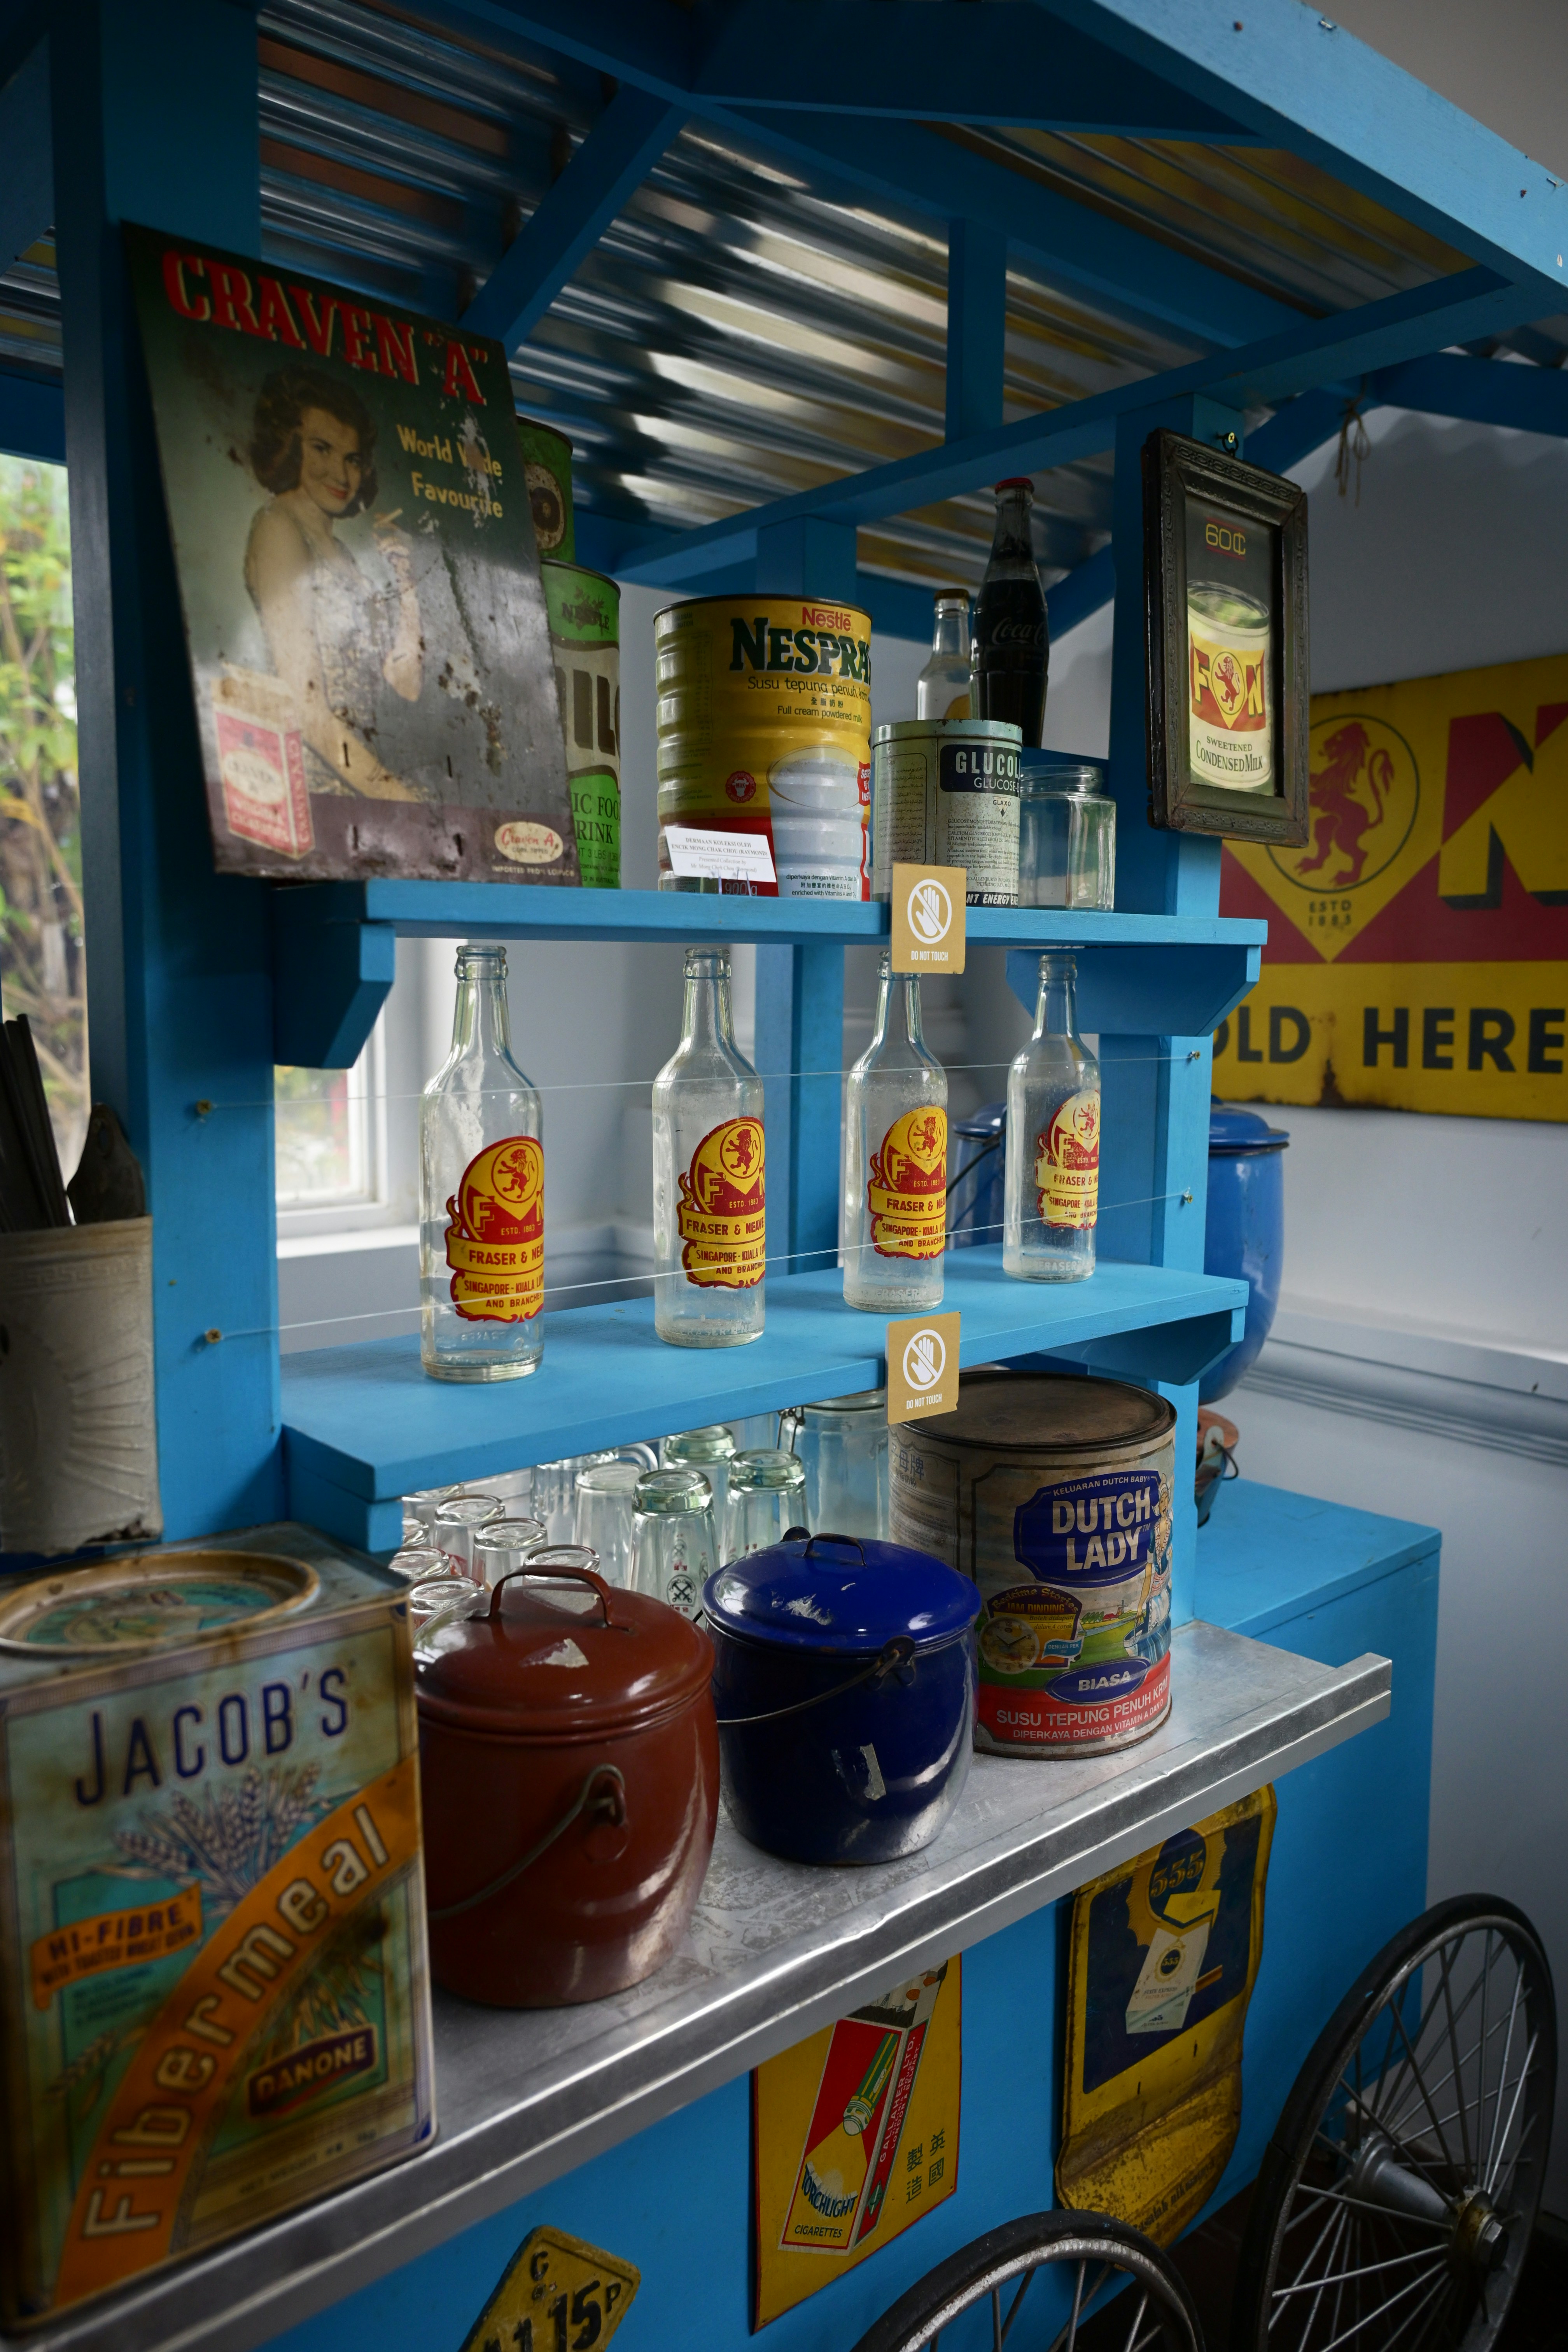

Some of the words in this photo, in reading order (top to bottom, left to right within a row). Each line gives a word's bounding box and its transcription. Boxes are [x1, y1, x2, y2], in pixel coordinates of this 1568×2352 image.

[162, 251, 419, 385] CRAVEN
[396, 424, 453, 464] World
[729, 617, 871, 687] NESPRA
[748, 677, 779, 689] Susu
[784, 677, 828, 694] tepung
[831, 684, 858, 698] penuh
[778, 705, 792, 714] Full
[794, 708, 819, 716] cream
[822, 710, 852, 720] powdered
[854, 714, 862, 723] milk
[1206, 735, 1252, 752] SWEETENED
[1196, 739, 1244, 772] CONDENSED
[1244, 751, 1263, 772] MILK
[597, 796, 621, 821] FOO
[576, 820, 613, 845] RINK
[725, 882, 747, 895] 900
[983, 894, 1010, 905] ENERGY
[1309, 900, 1352, 913] ESTD
[1309, 913, 1352, 927] 1883
[911, 951, 919, 961] DO
[920, 951, 930, 961] NOT
[931, 951, 948, 961] TOUCH
[1363, 1006, 1565, 1075] HERE
[1054, 1173, 1086, 1186] FRASER
[748, 1198, 758, 1206] 1883
[887, 1198, 924, 1213] FRASER
[928, 1201, 933, 1211] &
[1049, 1196, 1081, 1208] SINGAPORE
[523, 1225, 535, 1233] 1883
[686, 1219, 728, 1236] FRASER
[734, 1223, 741, 1235] &
[746, 1216, 764, 1234] NEAVE
[923, 1225, 938, 1236] KUALA
[899, 1238, 914, 1247] AND
[918, 1234, 944, 1247] BRANCHES
[469, 1250, 516, 1266] FRASER
[520, 1251, 528, 1264] &
[742, 1249, 758, 1261] KUALA
[716, 1265, 732, 1274] AND
[737, 1259, 764, 1274] BRANCHES
[516, 1279, 535, 1293] KUALA
[486, 1298, 504, 1308] AND
[510, 1292, 542, 1307] BRANCHES
[906, 1399, 913, 1410] DO
[914, 1397, 924, 1408] NOT
[926, 1393, 942, 1405] TOUCH
[1053, 1480, 1100, 1496] KELUARAN
[1102, 1477, 1128, 1486] DUTCH
[1052, 1486, 1150, 1534] DUTCH
[1066, 1526, 1143, 1570] LADY
[992, 1588, 1037, 1609] Bedtime
[1041, 1587, 1078, 1613] Stories
[1007, 1603, 1024, 1612] JAM
[1028, 1603, 1064, 1613] DINDING
[1078, 1671, 1132, 1691] BIASA
[996, 1710, 1041, 1726] SUSU
[1046, 1708, 1110, 1726] TEPUNG
[1113, 1691, 1151, 1718] PENUH
[1013, 1729, 1070, 1739] DIPERKAYA
[1073, 1727, 1113, 1738] DENGAN
[1114, 1714, 1143, 1730] VITAMIN
[1150, 1704, 1160, 1716] DAN
[75, 1668, 348, 1807] JACOB'S
[1150, 1848, 1204, 1898] 555
[256, 2035, 367, 2100] DANONE
[880, 2077, 905, 2163] GALLAHER
[891, 2103, 906, 2149] LONDON
[928, 2128, 946, 2187] 英國
[802, 2163, 858, 2218] TORCHLIGHT
[794, 2224, 843, 2238] CIGARETTES
